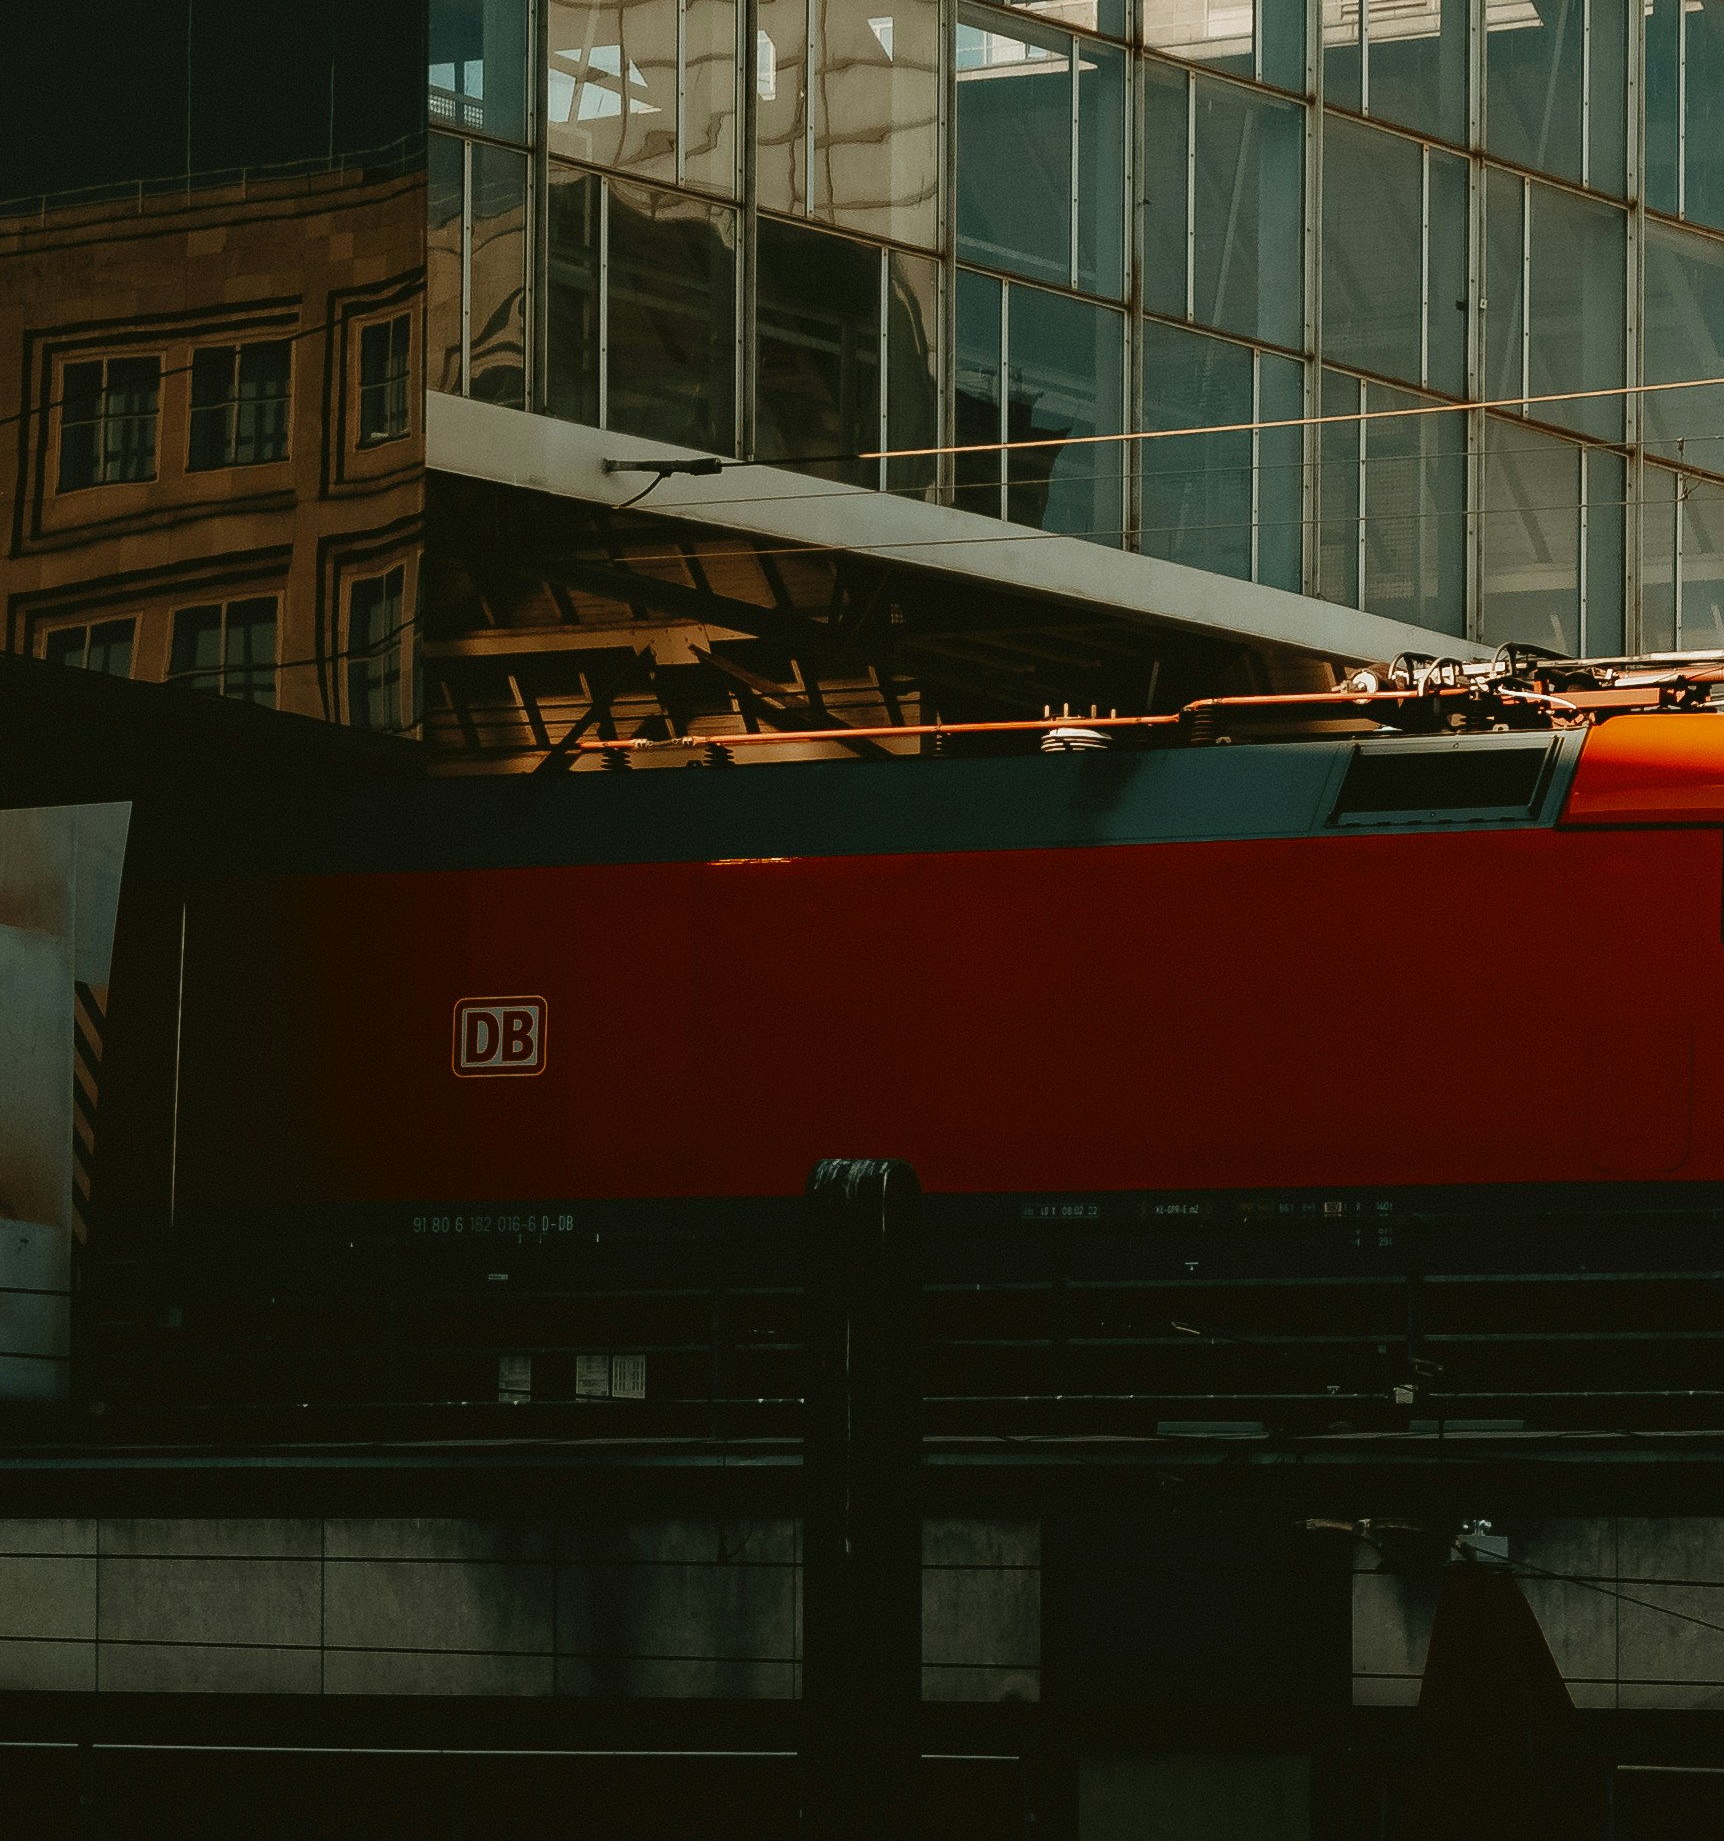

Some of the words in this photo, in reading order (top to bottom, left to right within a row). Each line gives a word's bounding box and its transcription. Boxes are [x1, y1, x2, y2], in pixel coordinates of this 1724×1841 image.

[465, 1009, 535, 1064] DB
[413, 1217, 427, 1233] 91
[431, 1217, 451, 1233] 80
[454, 1217, 465, 1233] 6
[470, 1216, 493, 1233] 182
[497, 1215, 537, 1232] 016-6
[541, 1214, 574, 1231] D-DB
